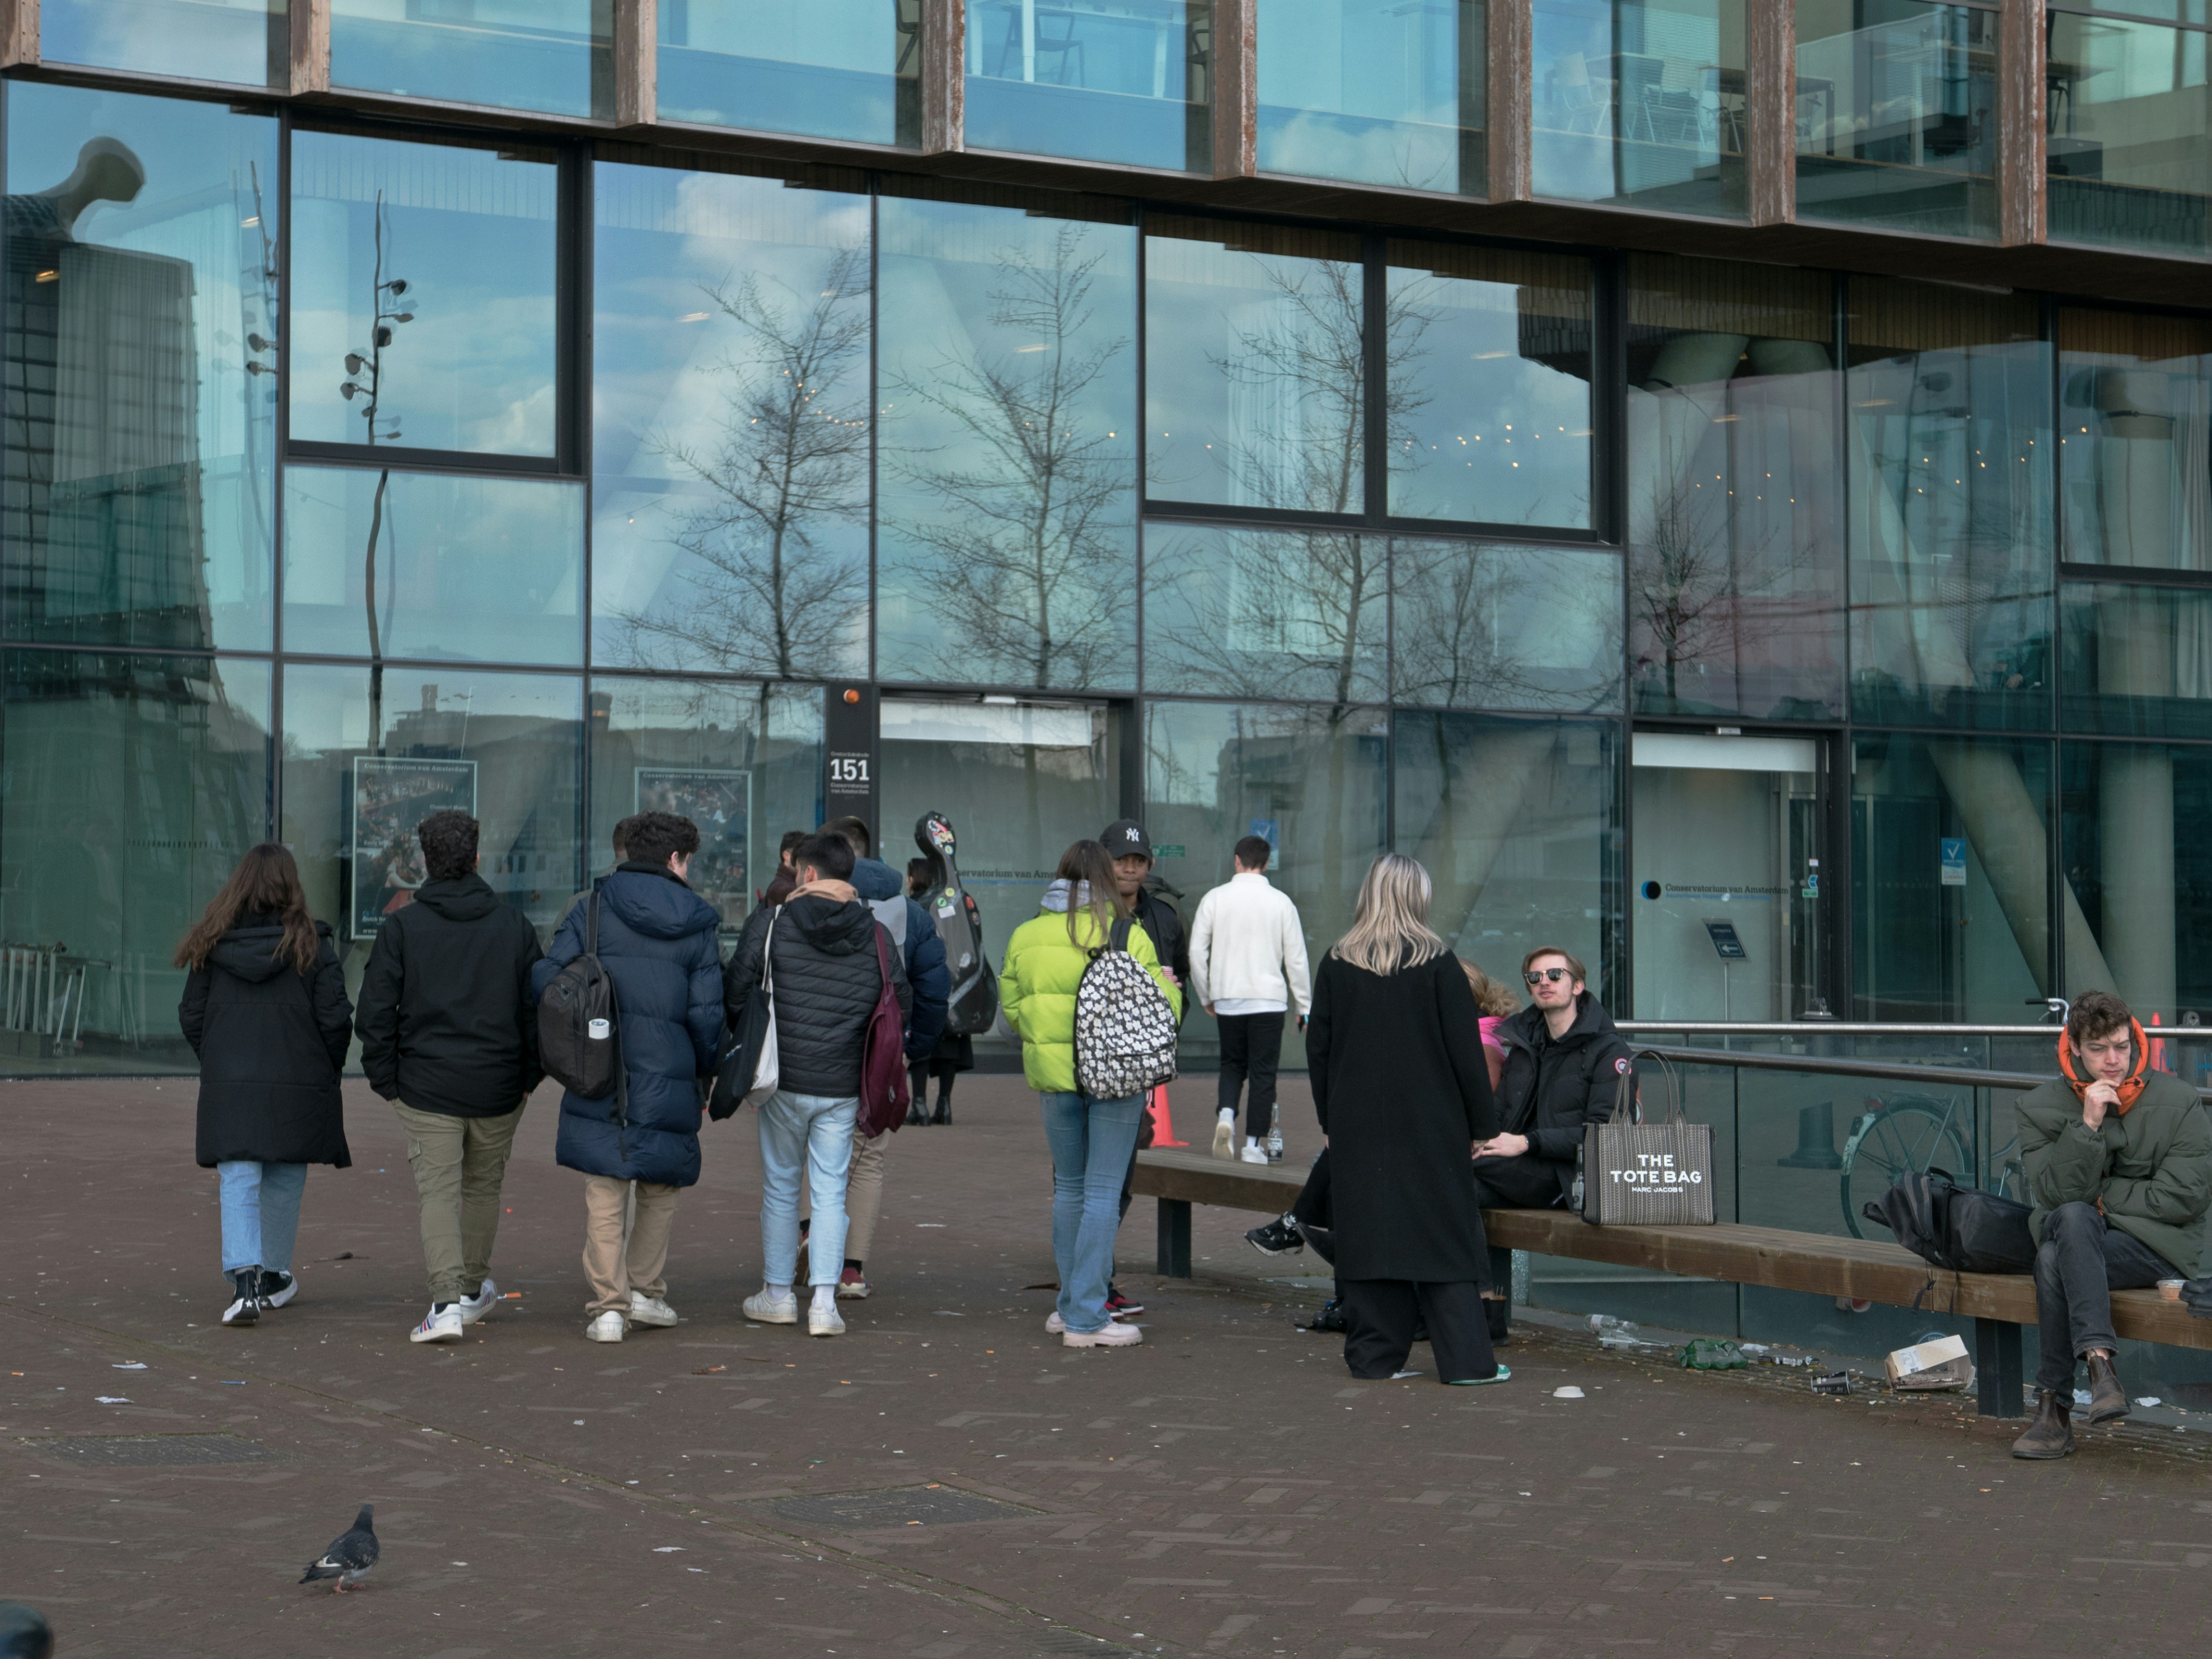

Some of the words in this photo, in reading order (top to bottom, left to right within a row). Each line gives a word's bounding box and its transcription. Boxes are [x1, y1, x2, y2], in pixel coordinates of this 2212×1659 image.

[364, 763, 416, 771] Conservatorium
[831, 758, 869, 781] 151
[1665, 883, 1727, 893] Conservatorium
[1744, 885, 1789, 894] Amsterdam
[1638, 1154, 1674, 1167] THE
[1610, 1170, 1660, 1183] TOTE
[1664, 1171, 1702, 1184] BAG
